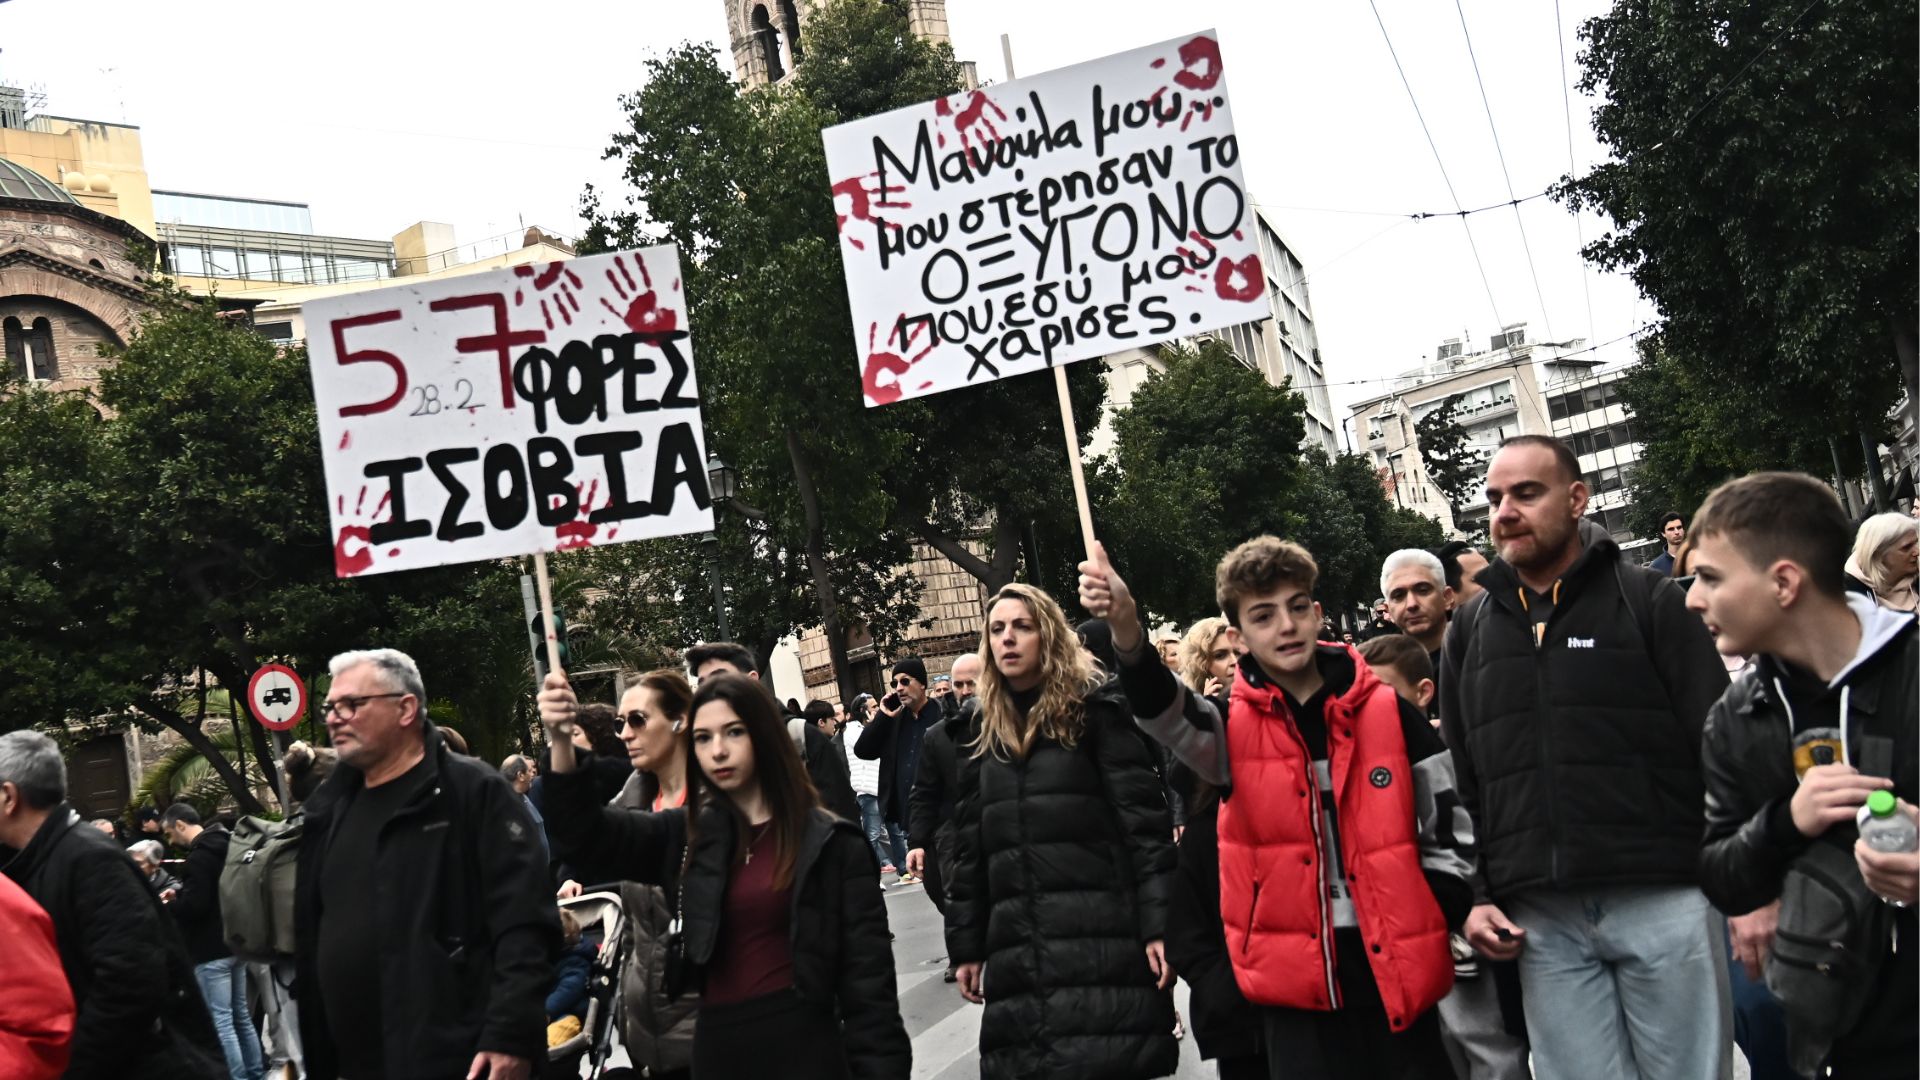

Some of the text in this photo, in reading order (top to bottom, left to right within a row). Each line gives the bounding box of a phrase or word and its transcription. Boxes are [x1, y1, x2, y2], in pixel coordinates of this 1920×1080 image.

[877, 212, 949, 270] μου
[959, 145, 1173, 227] στέρησαν
[921, 175, 1244, 305] ΟΞΥΓΟΝΟ
[897, 248, 1217, 352] που εσύ μου
[409, 378, 486, 417] 28.2
[513, 330, 700, 434] ΦΟΡΕΣ
[364, 422, 713, 546] ΙΣΟΒΙΑ
